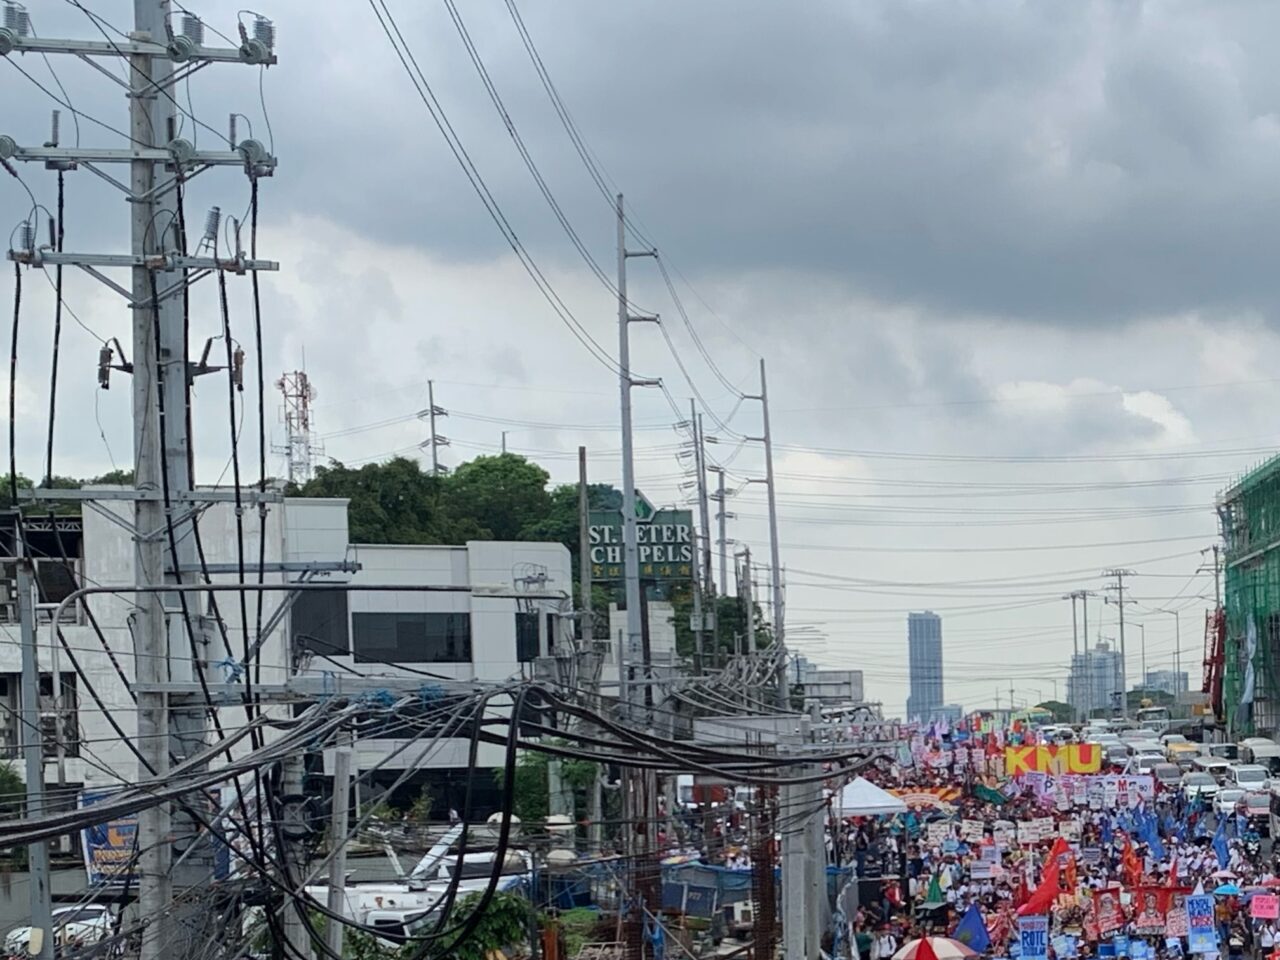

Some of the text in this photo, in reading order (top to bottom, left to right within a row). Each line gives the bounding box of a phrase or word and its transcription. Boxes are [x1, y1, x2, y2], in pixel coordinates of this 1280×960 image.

[589, 524, 690, 543] ST. ETER
[591, 545, 692, 563] CHPELS
[1005, 744, 1101, 777] KMU
[1021, 931, 1046, 945] ROTC
